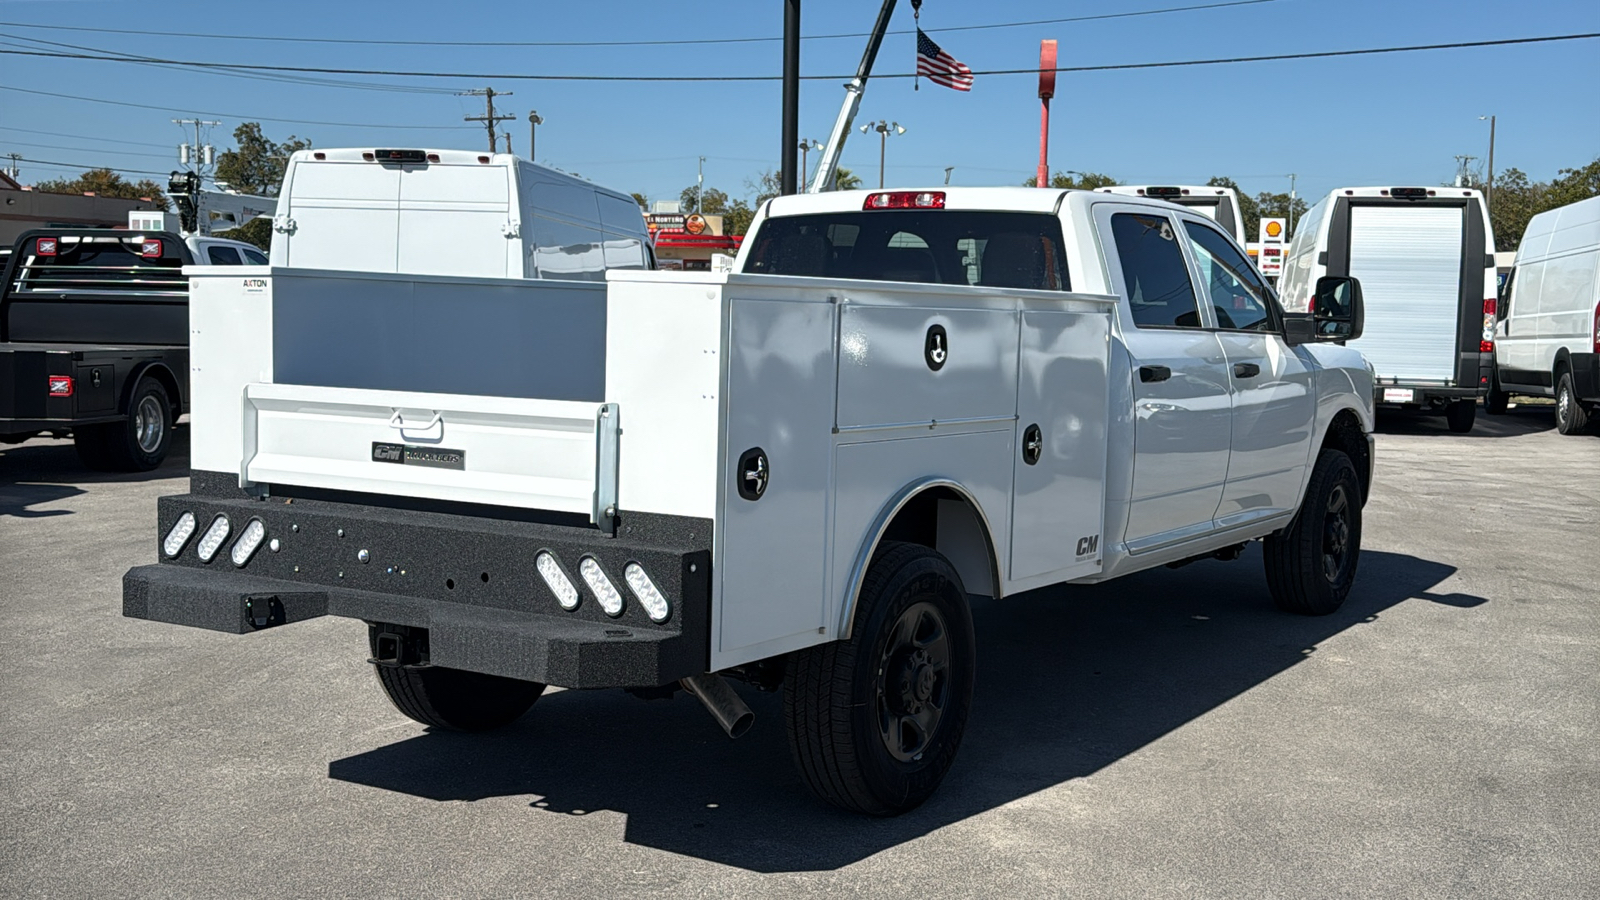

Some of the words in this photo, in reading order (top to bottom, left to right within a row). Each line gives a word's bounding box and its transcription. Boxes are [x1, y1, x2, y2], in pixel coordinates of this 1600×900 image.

[243, 279, 267, 287] AXTON
[374, 444, 402, 461] CM
[1076, 534, 1099, 556] CM
